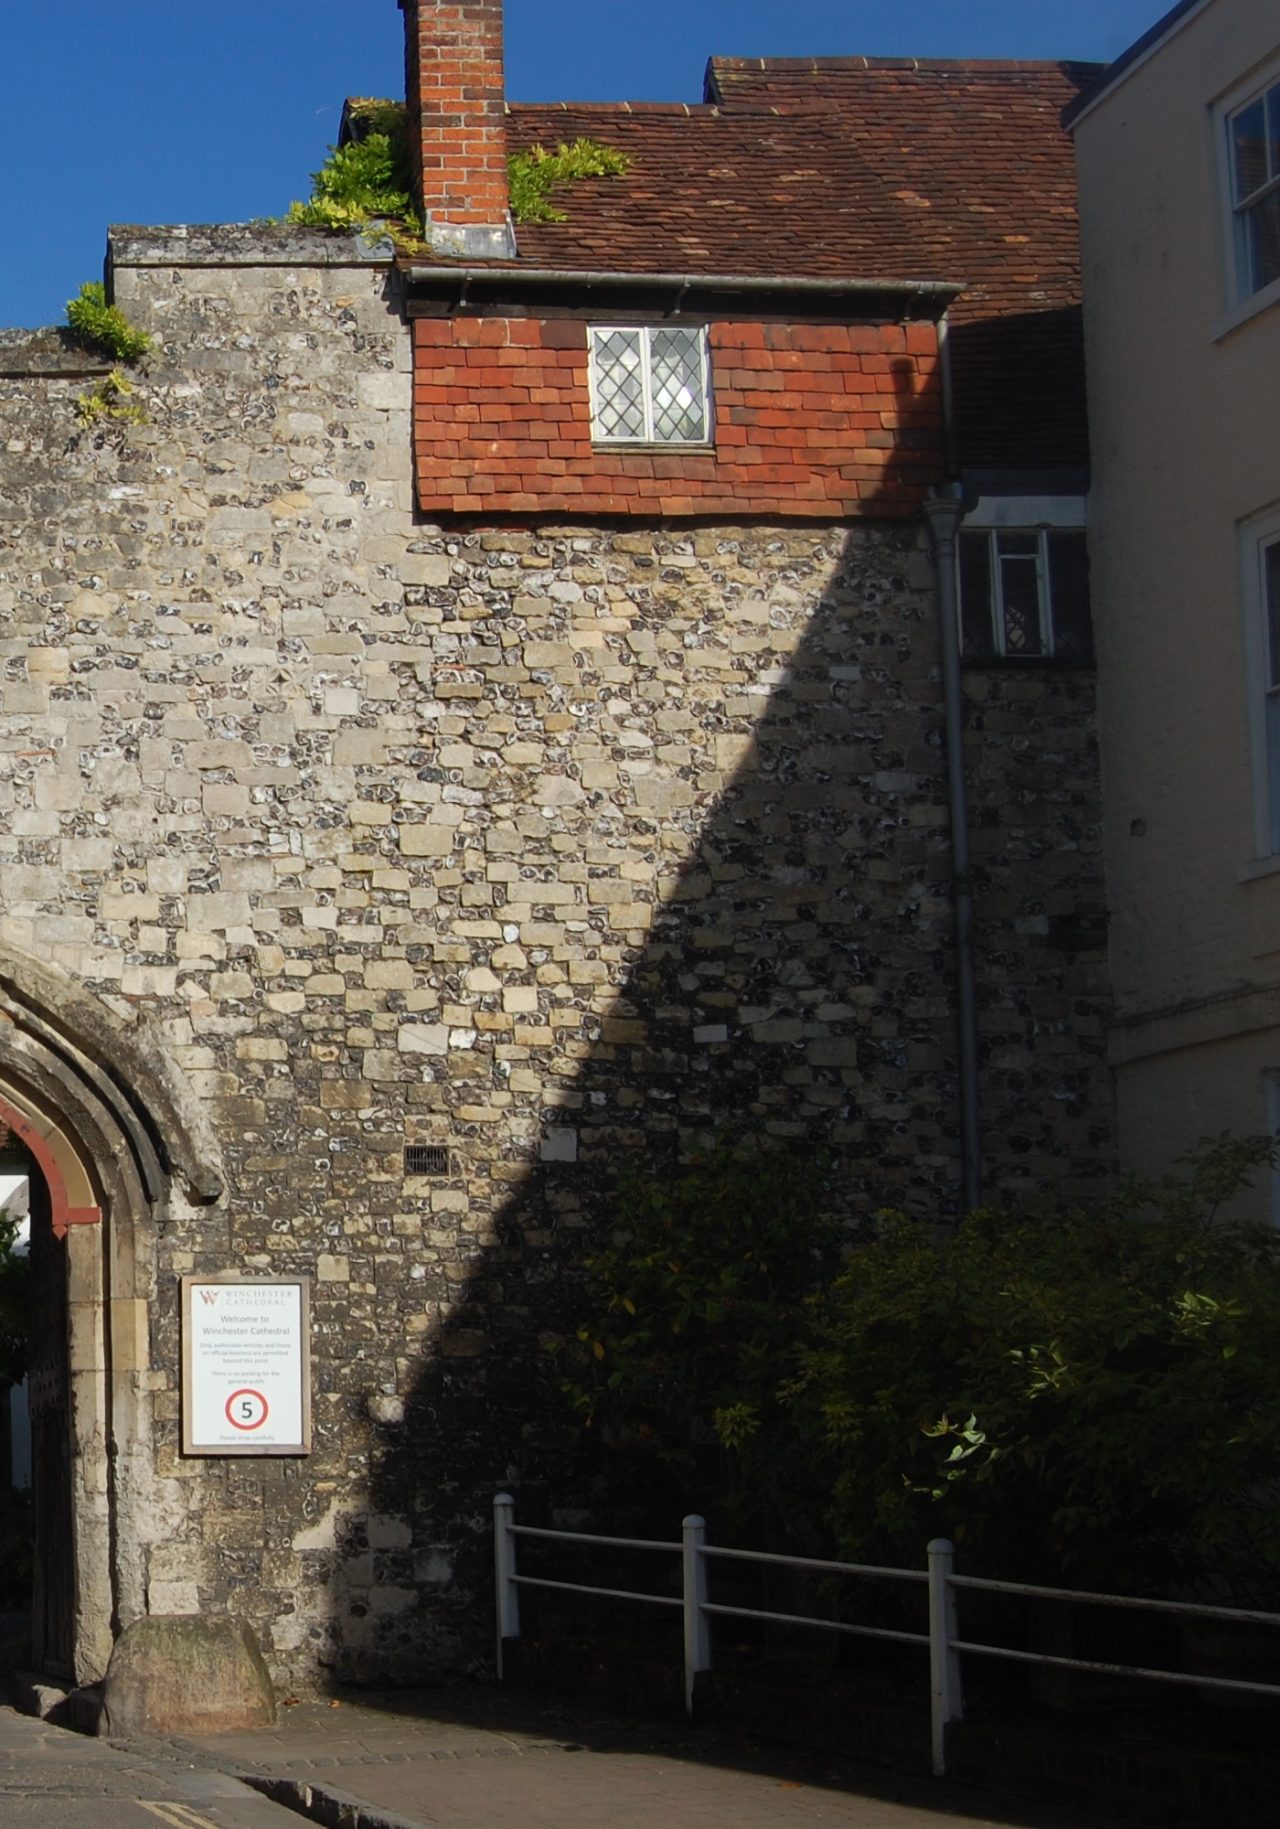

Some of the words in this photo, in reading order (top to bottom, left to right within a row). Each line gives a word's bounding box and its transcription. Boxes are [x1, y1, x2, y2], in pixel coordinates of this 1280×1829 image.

[220, 1315, 258, 1323] Welcome
[260, 1315, 269, 1323] to
[202, 1327, 248, 1335] Winchester
[250, 1327, 290, 1335] Cathedral
[241, 1402, 253, 1418] 5
